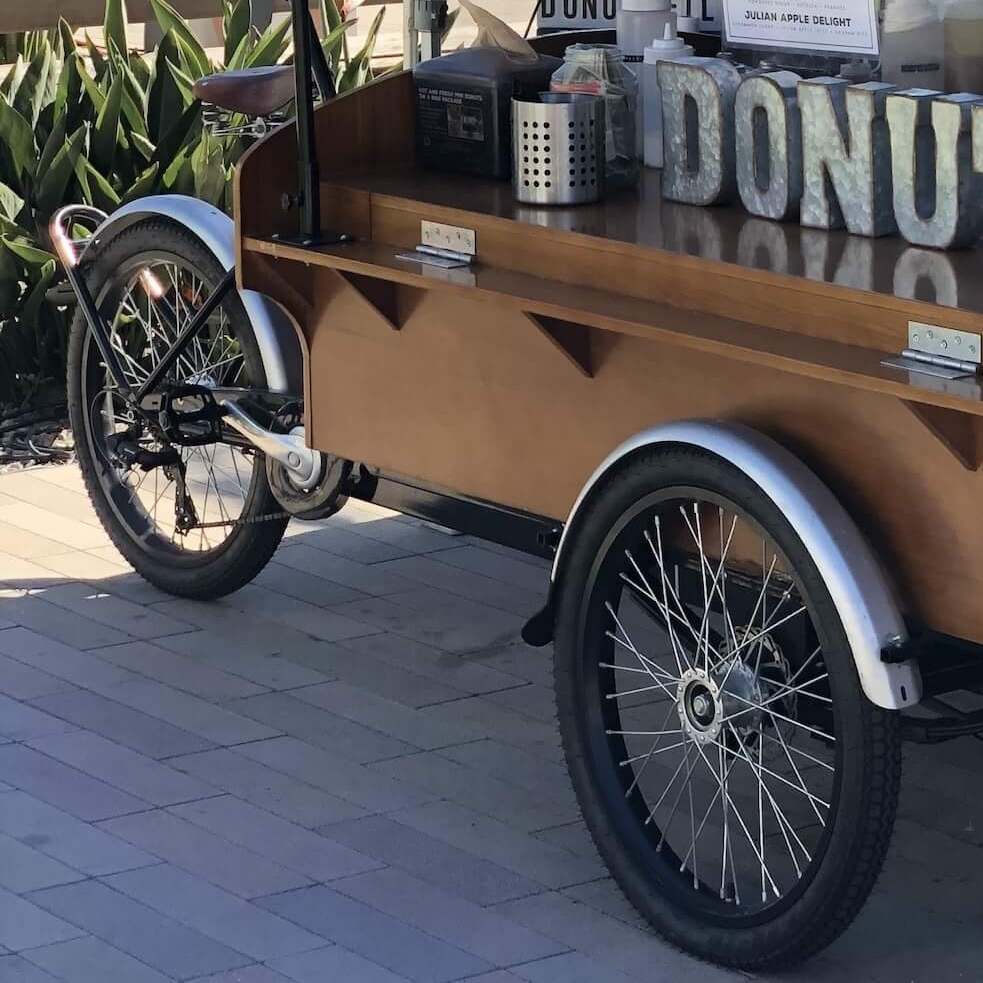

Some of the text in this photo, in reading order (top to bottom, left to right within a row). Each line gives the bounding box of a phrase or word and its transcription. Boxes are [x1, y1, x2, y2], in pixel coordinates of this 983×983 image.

[744, 10, 852, 27] JULIAN APPLE DELIGHT
